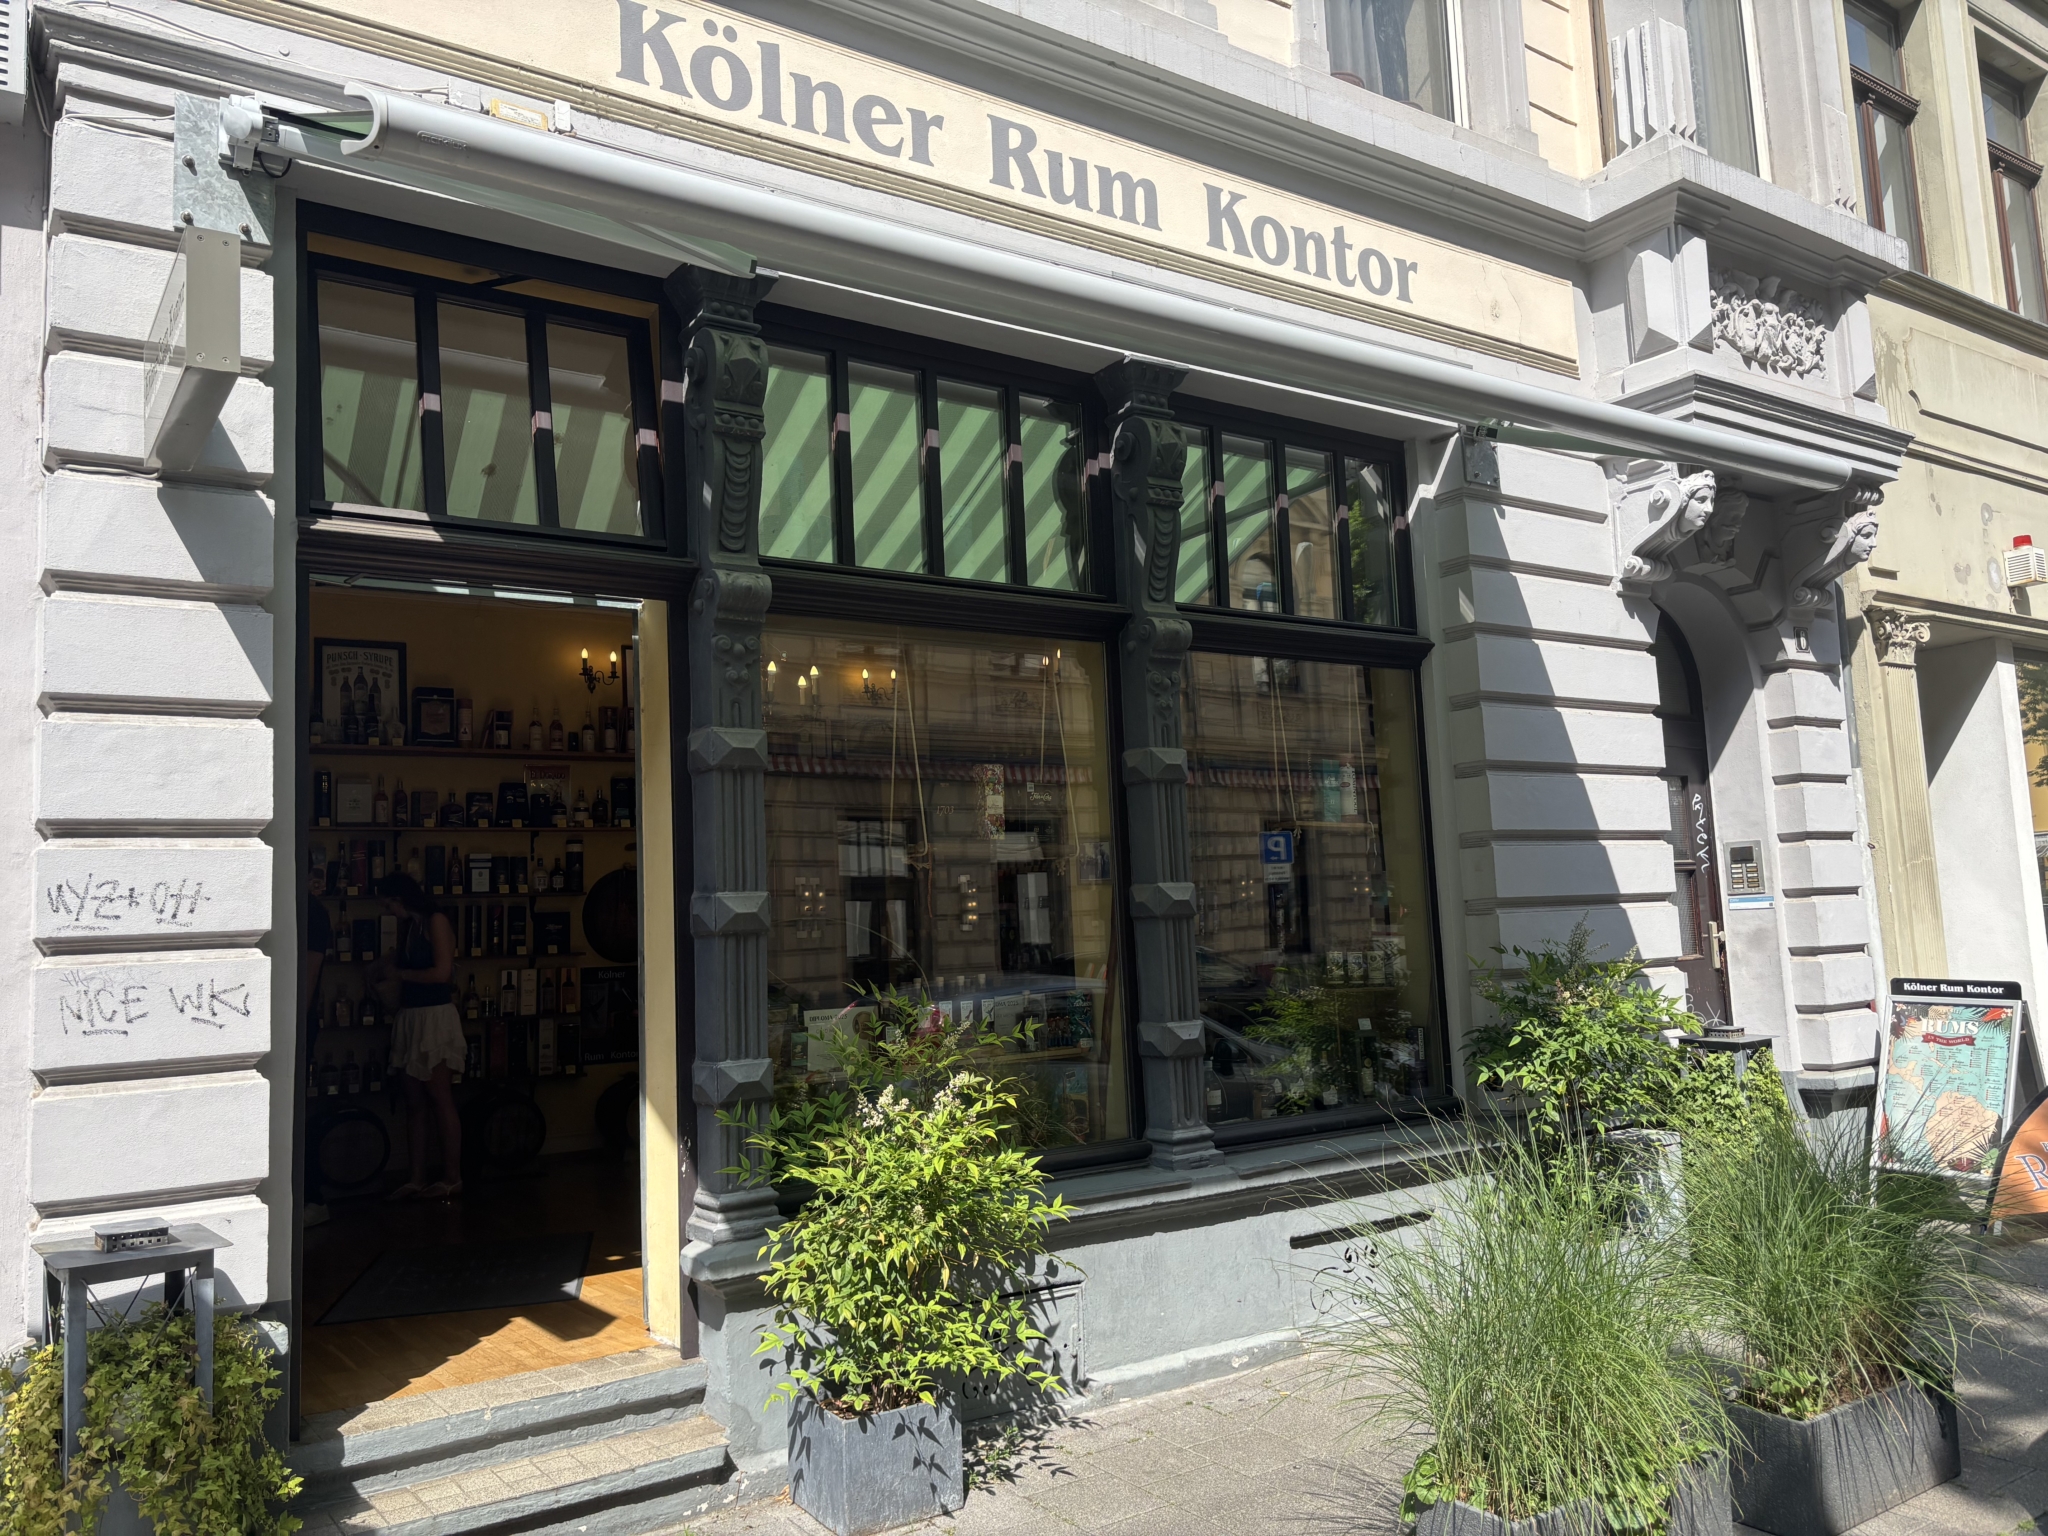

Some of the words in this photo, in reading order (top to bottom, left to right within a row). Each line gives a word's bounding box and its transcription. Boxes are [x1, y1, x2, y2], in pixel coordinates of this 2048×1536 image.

[616, 0, 944, 167] Kölner
[987, 114, 1162, 231] Rum
[1205, 184, 1418, 304] Kontor
[326, 651, 358, 664] PUNSCH
[361, 651, 394, 667] SYRUPE
[935, 805, 955, 817] 1703
[598, 970, 626, 980] Kölner
[1903, 982, 1938, 992] Kölner
[1940, 983, 1964, 993] Rum
[1967, 984, 2005, 994] Kontor
[59, 984, 150, 1035] NICE
[1921, 1018, 1979, 1036] RUMS
[1948, 1037, 1971, 1045] WORLD
[584, 1053, 605, 1062] Rum
